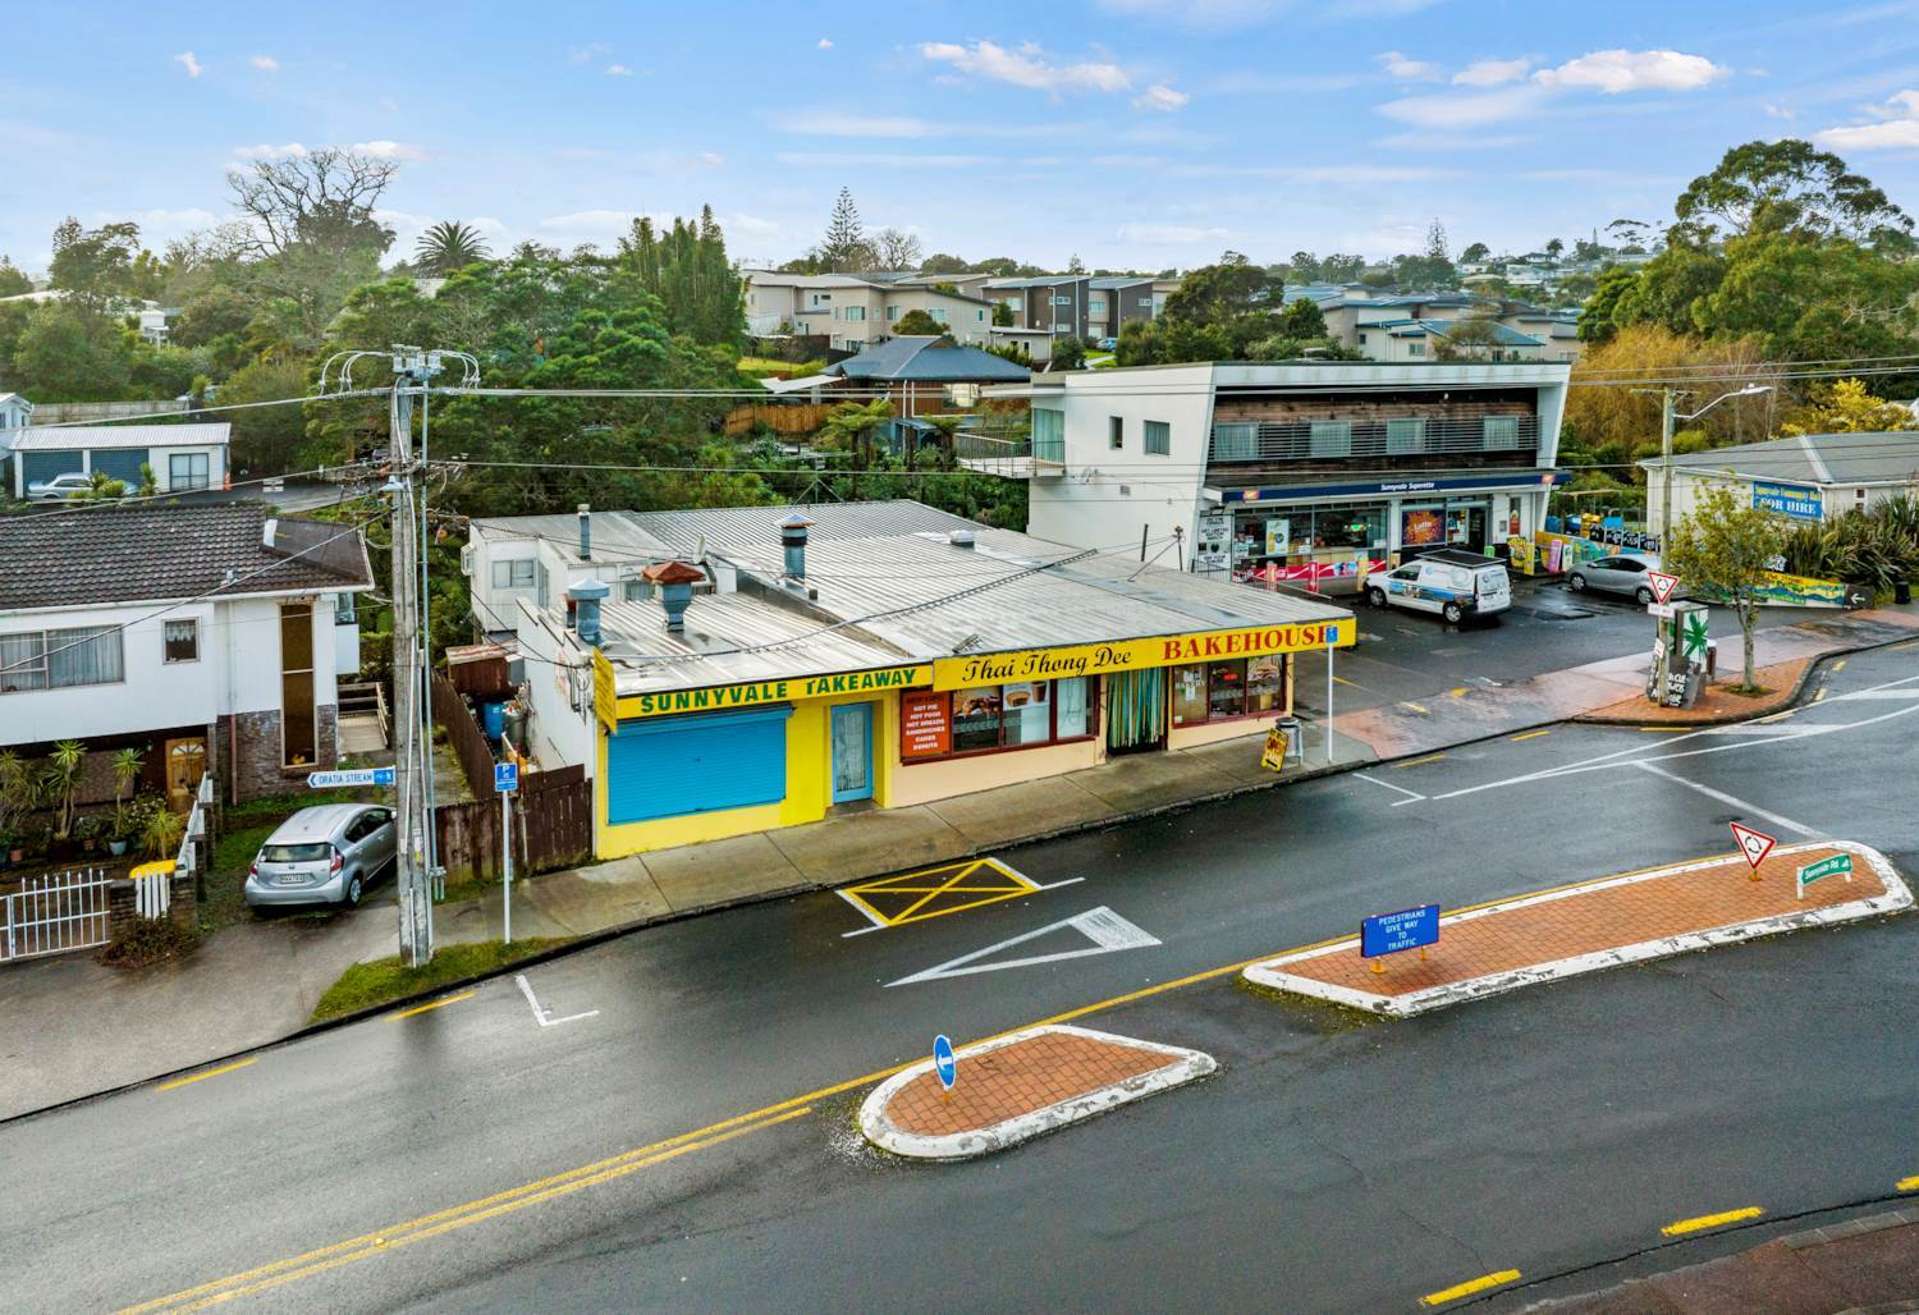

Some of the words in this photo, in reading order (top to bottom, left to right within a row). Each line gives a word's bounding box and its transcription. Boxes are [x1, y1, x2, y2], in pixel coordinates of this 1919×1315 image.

[1786, 500, 1816, 515] HIRE
[962, 658, 1016, 682] Thai
[1021, 653, 1087, 676] Thong
[1094, 646, 1131, 668] Dee
[641, 682, 788, 713] SUNNYVALE
[806, 668, 916, 695] TAKEAWAY
[319, 774, 343, 783] ORATIA
[345, 773, 373, 782] STREAM
[1378, 909, 1426, 927] PEDESTRIANS
[1385, 923, 1402, 934] GIVE
[1404, 919, 1419, 929] WAY
[1398, 931, 1407, 940] TO
[1388, 938, 1417, 951] TRAFFIC
